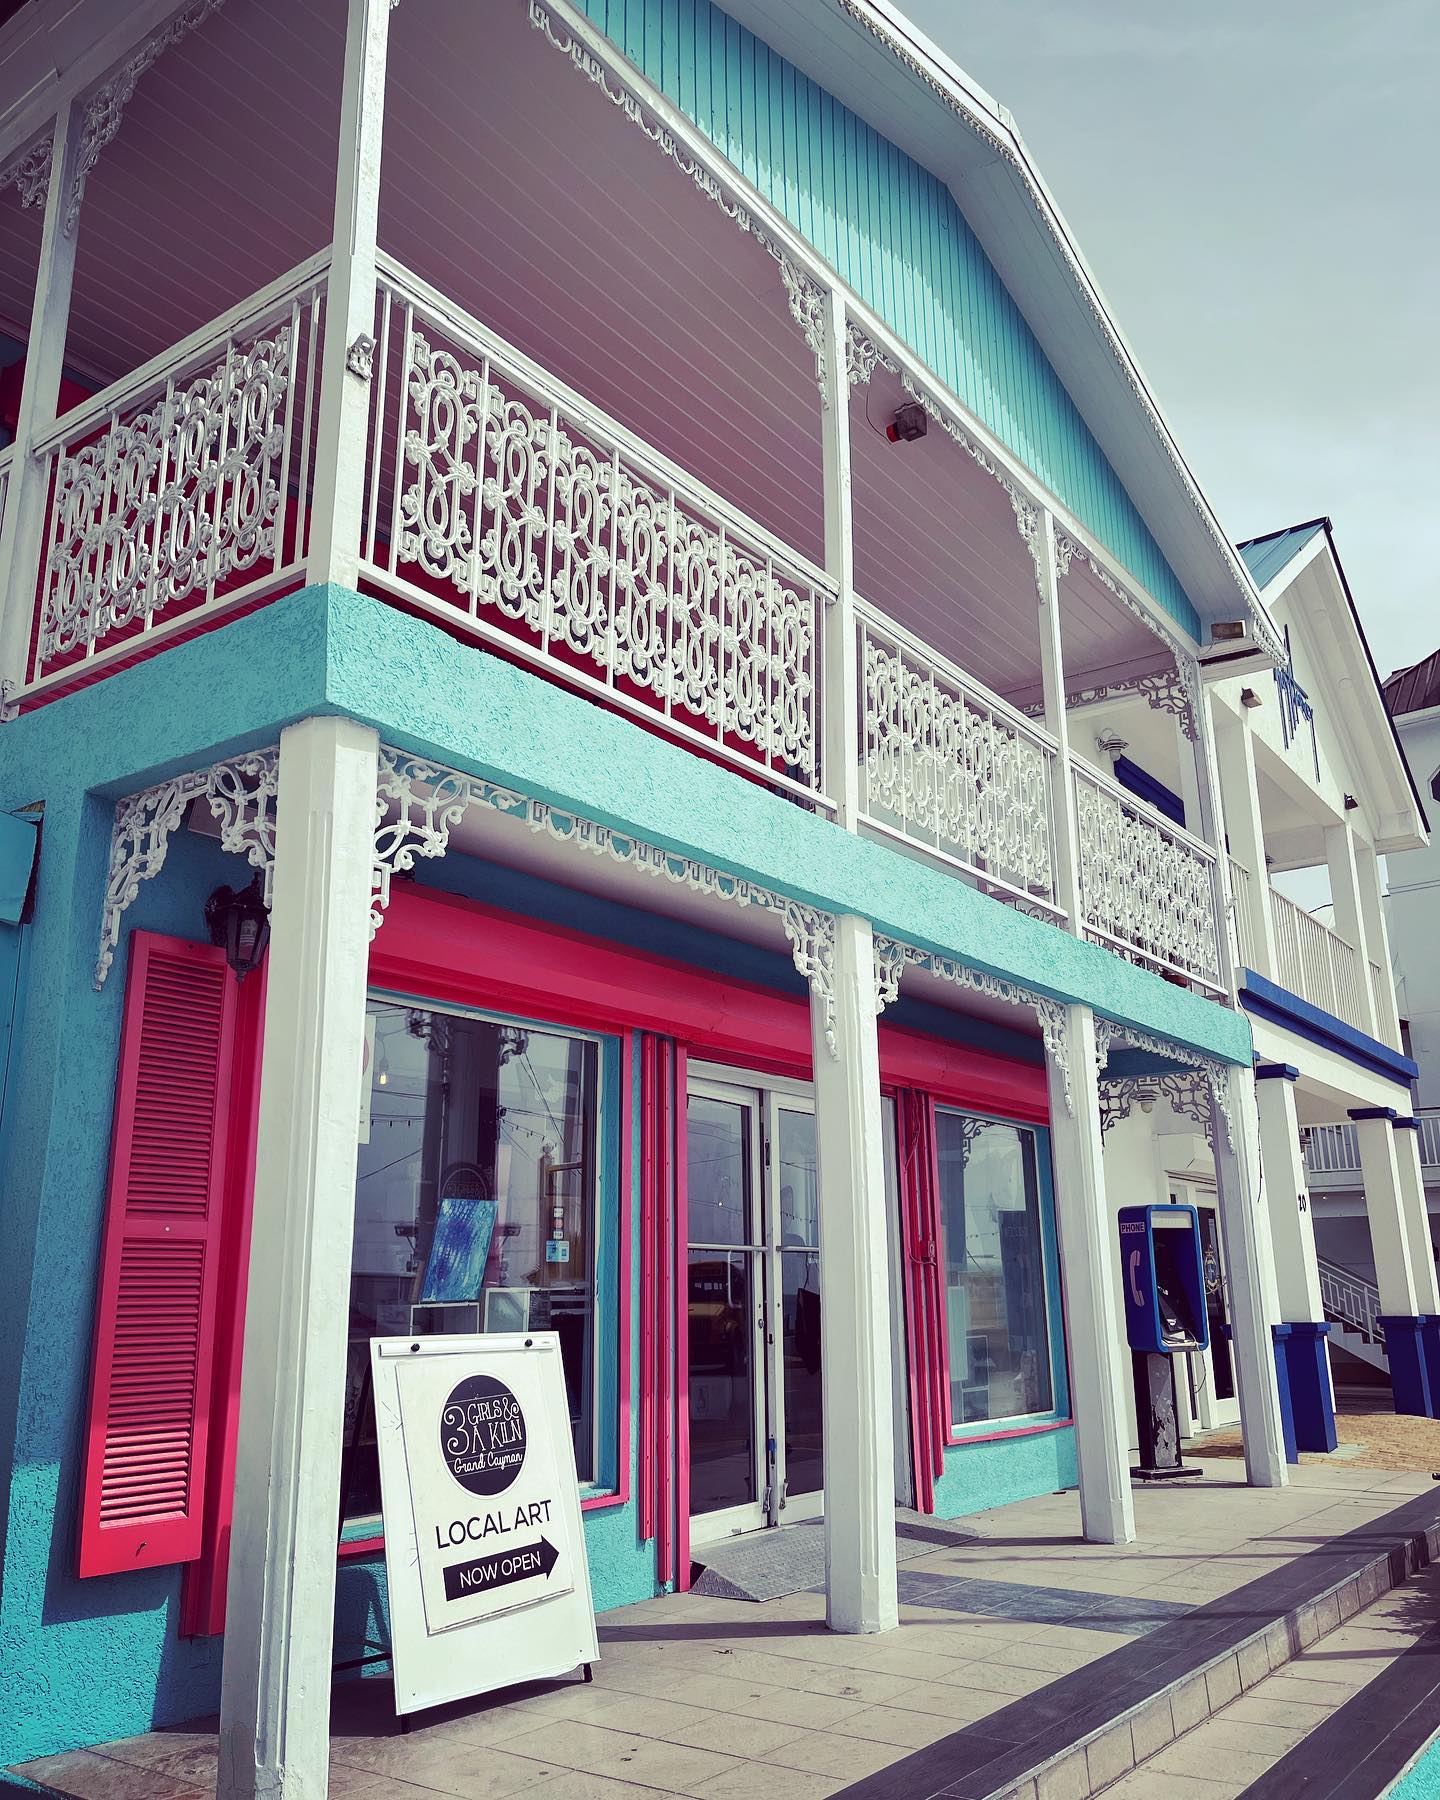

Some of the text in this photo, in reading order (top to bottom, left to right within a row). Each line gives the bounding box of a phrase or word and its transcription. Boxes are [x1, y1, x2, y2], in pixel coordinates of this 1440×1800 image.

[1121, 1222, 1145, 1232] PHONE
[443, 1406, 470, 1455] 3
[472, 1419, 523, 1454] A KILN
[454, 1451, 524, 1473] Grand Cayman
[435, 1499, 552, 1549] LOCAL ART
[460, 1551, 542, 1589] NOW OPEN
